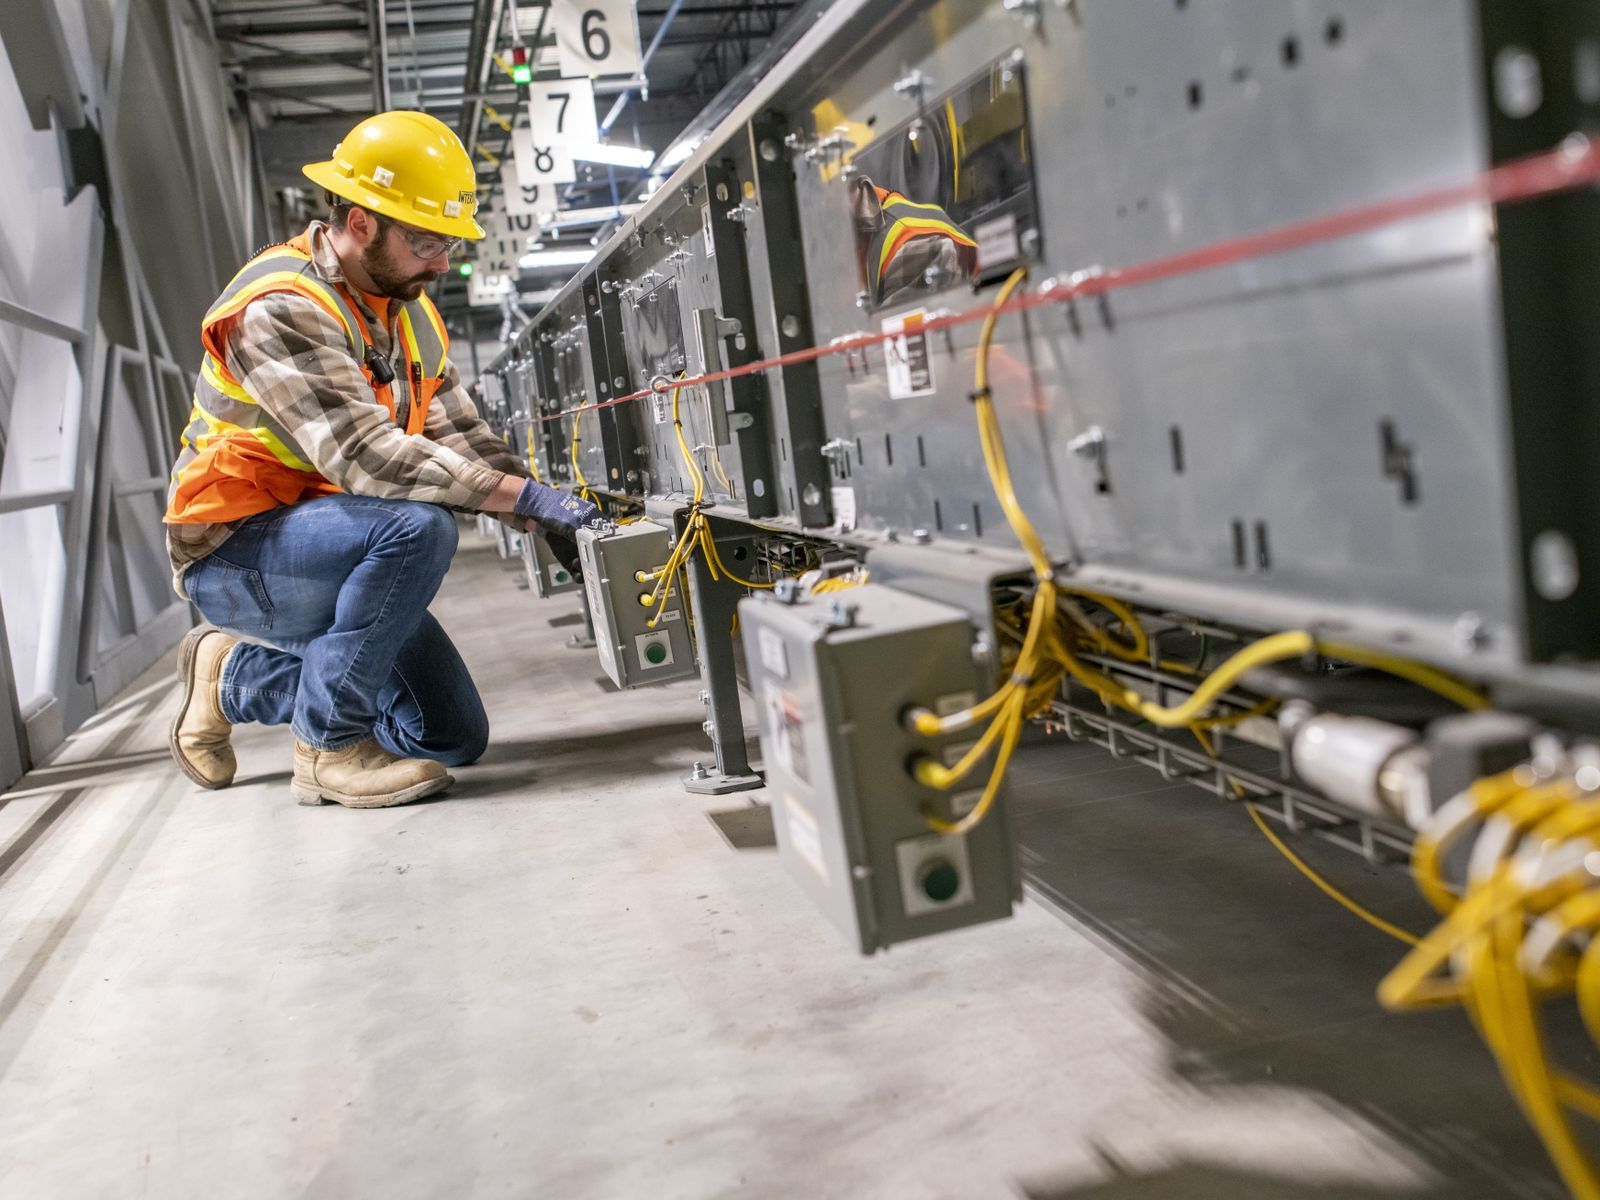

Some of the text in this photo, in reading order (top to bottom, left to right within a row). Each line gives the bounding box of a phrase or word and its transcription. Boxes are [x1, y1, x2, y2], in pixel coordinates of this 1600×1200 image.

[582, 9, 611, 61] 6
[547, 93, 570, 133] 7
[533, 146, 554, 173] 8
